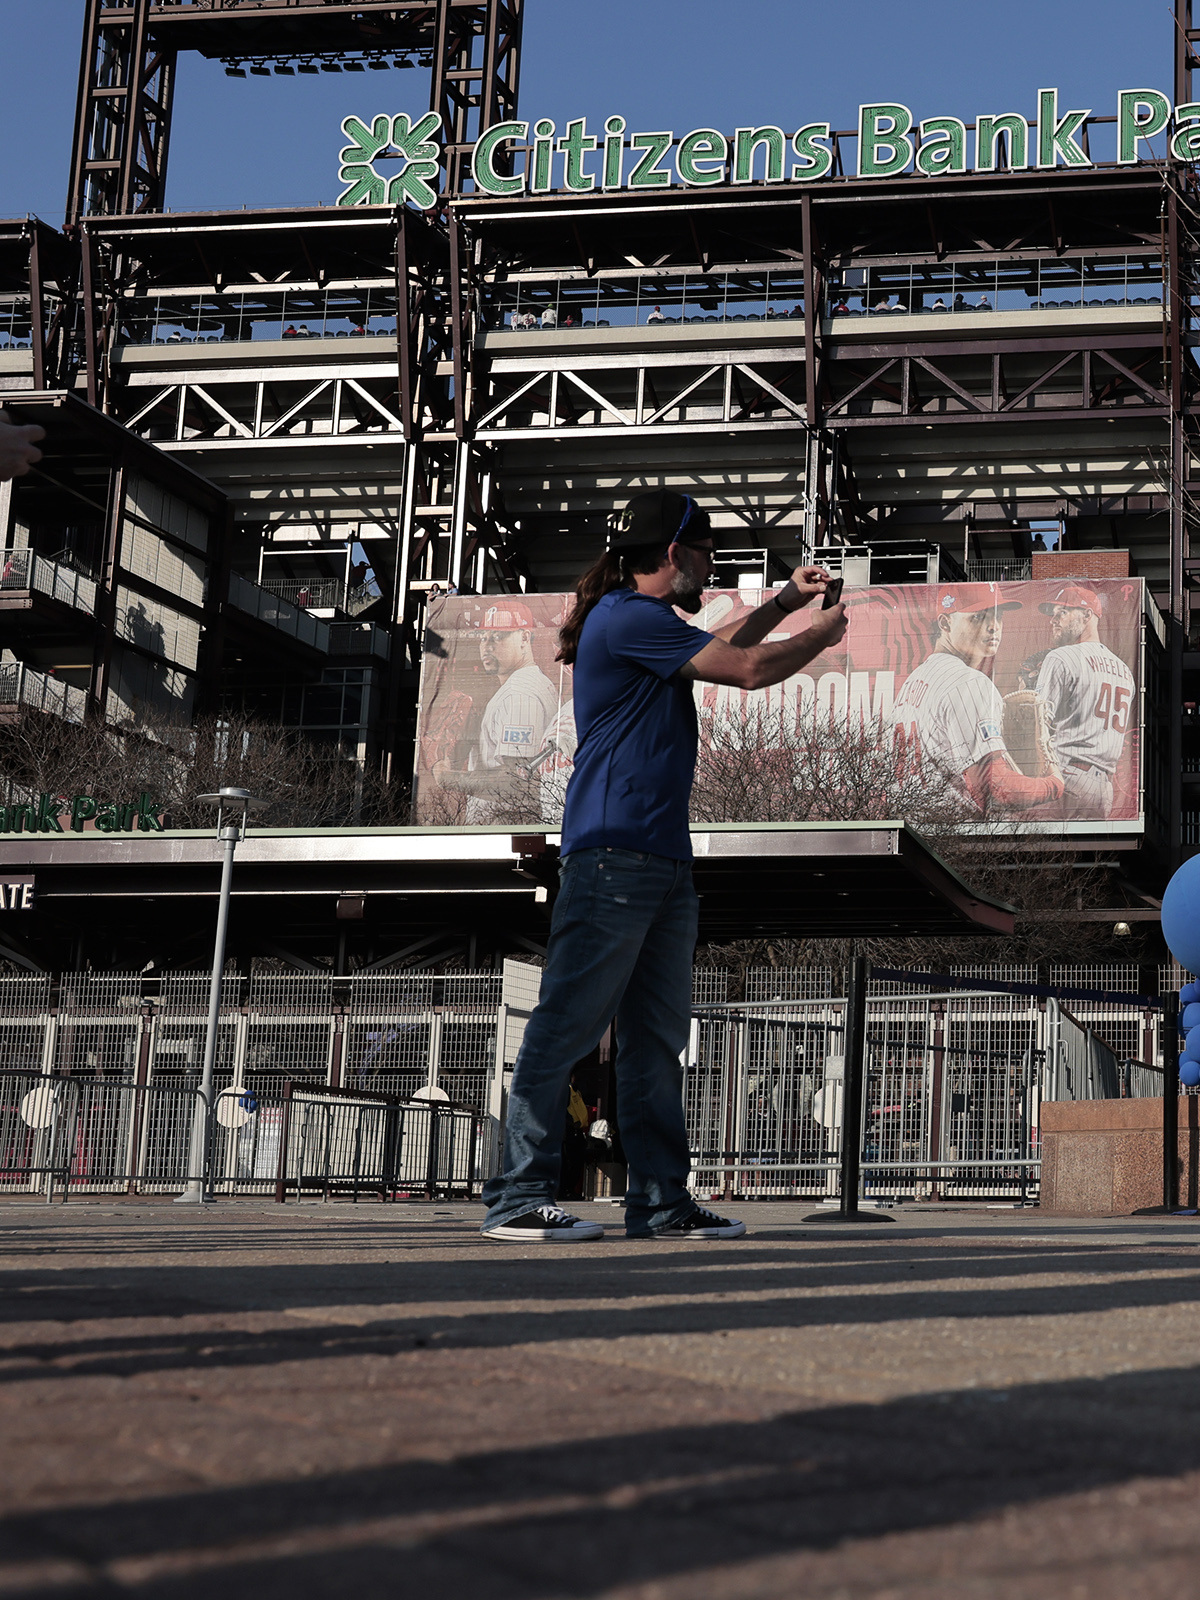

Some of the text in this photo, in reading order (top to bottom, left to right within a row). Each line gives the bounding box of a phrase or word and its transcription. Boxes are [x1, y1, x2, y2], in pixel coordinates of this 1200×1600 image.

[470, 112, 833, 197] Citizens
[856, 86, 1092, 181] Bank
[1094, 681, 1131, 734] 45
[504, 730, 532, 744] IBX
[70, 792, 165, 833] Park
